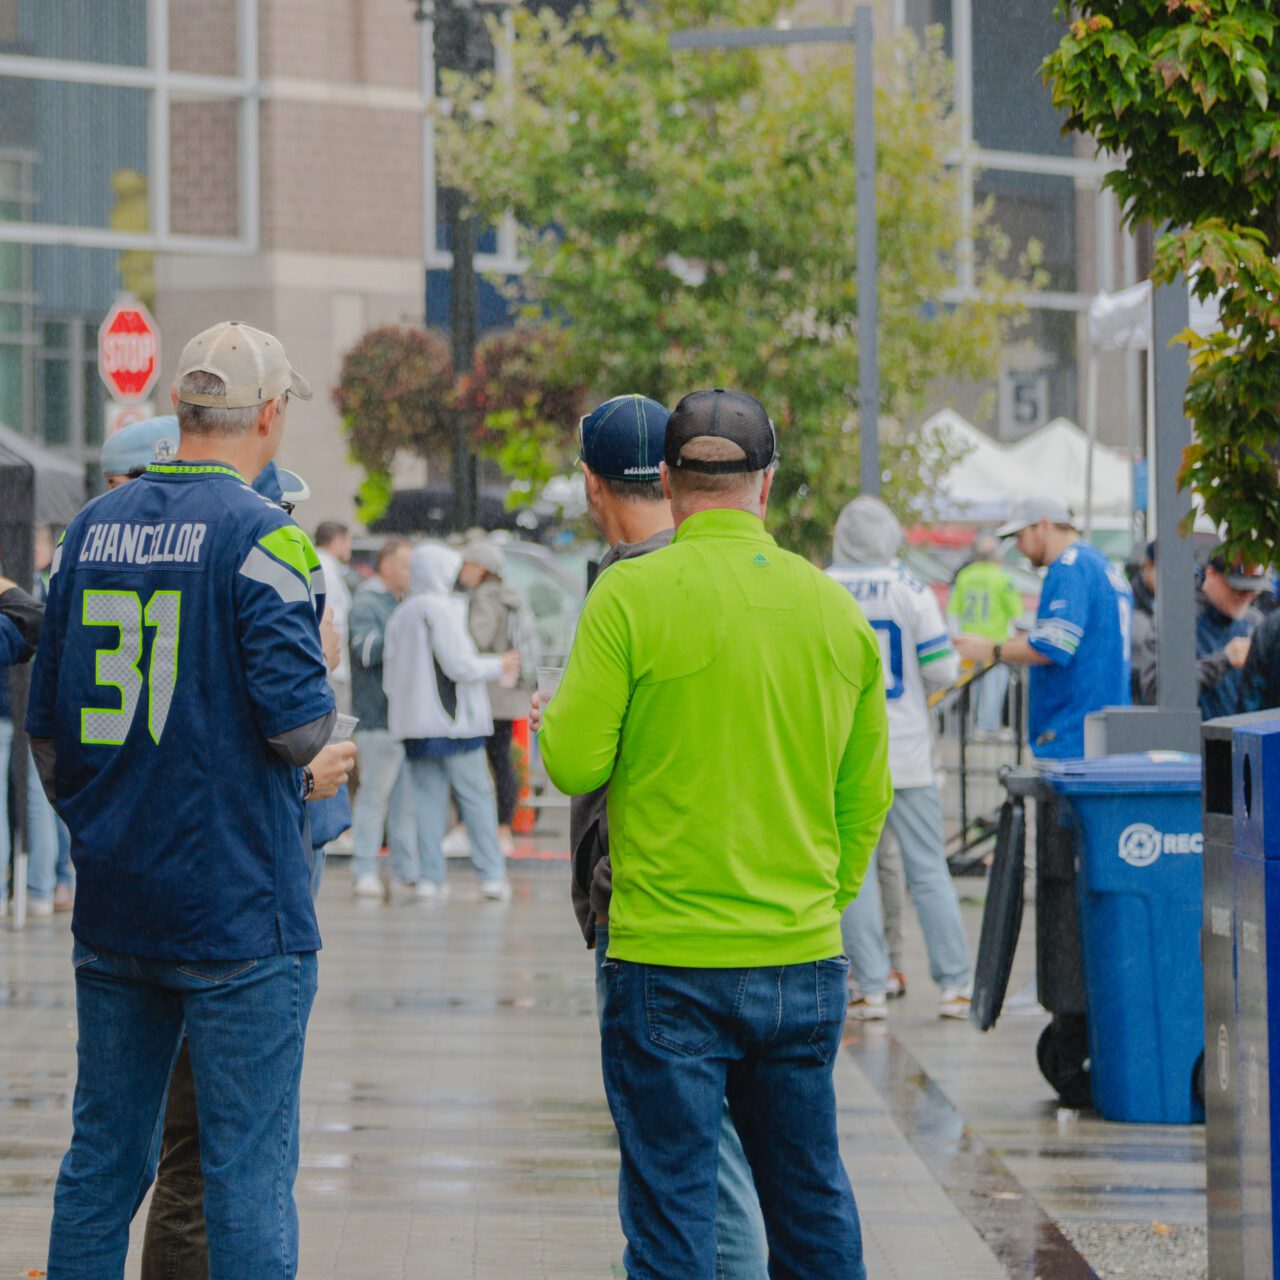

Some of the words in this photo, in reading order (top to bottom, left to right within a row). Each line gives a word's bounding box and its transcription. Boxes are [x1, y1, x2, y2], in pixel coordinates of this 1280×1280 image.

[104, 332, 155, 373] STOP
[1014, 385, 1038, 425] 5
[845, 579, 890, 599] GENT
[81, 589, 181, 746] 31
[1163, 832, 1204, 855] REC
